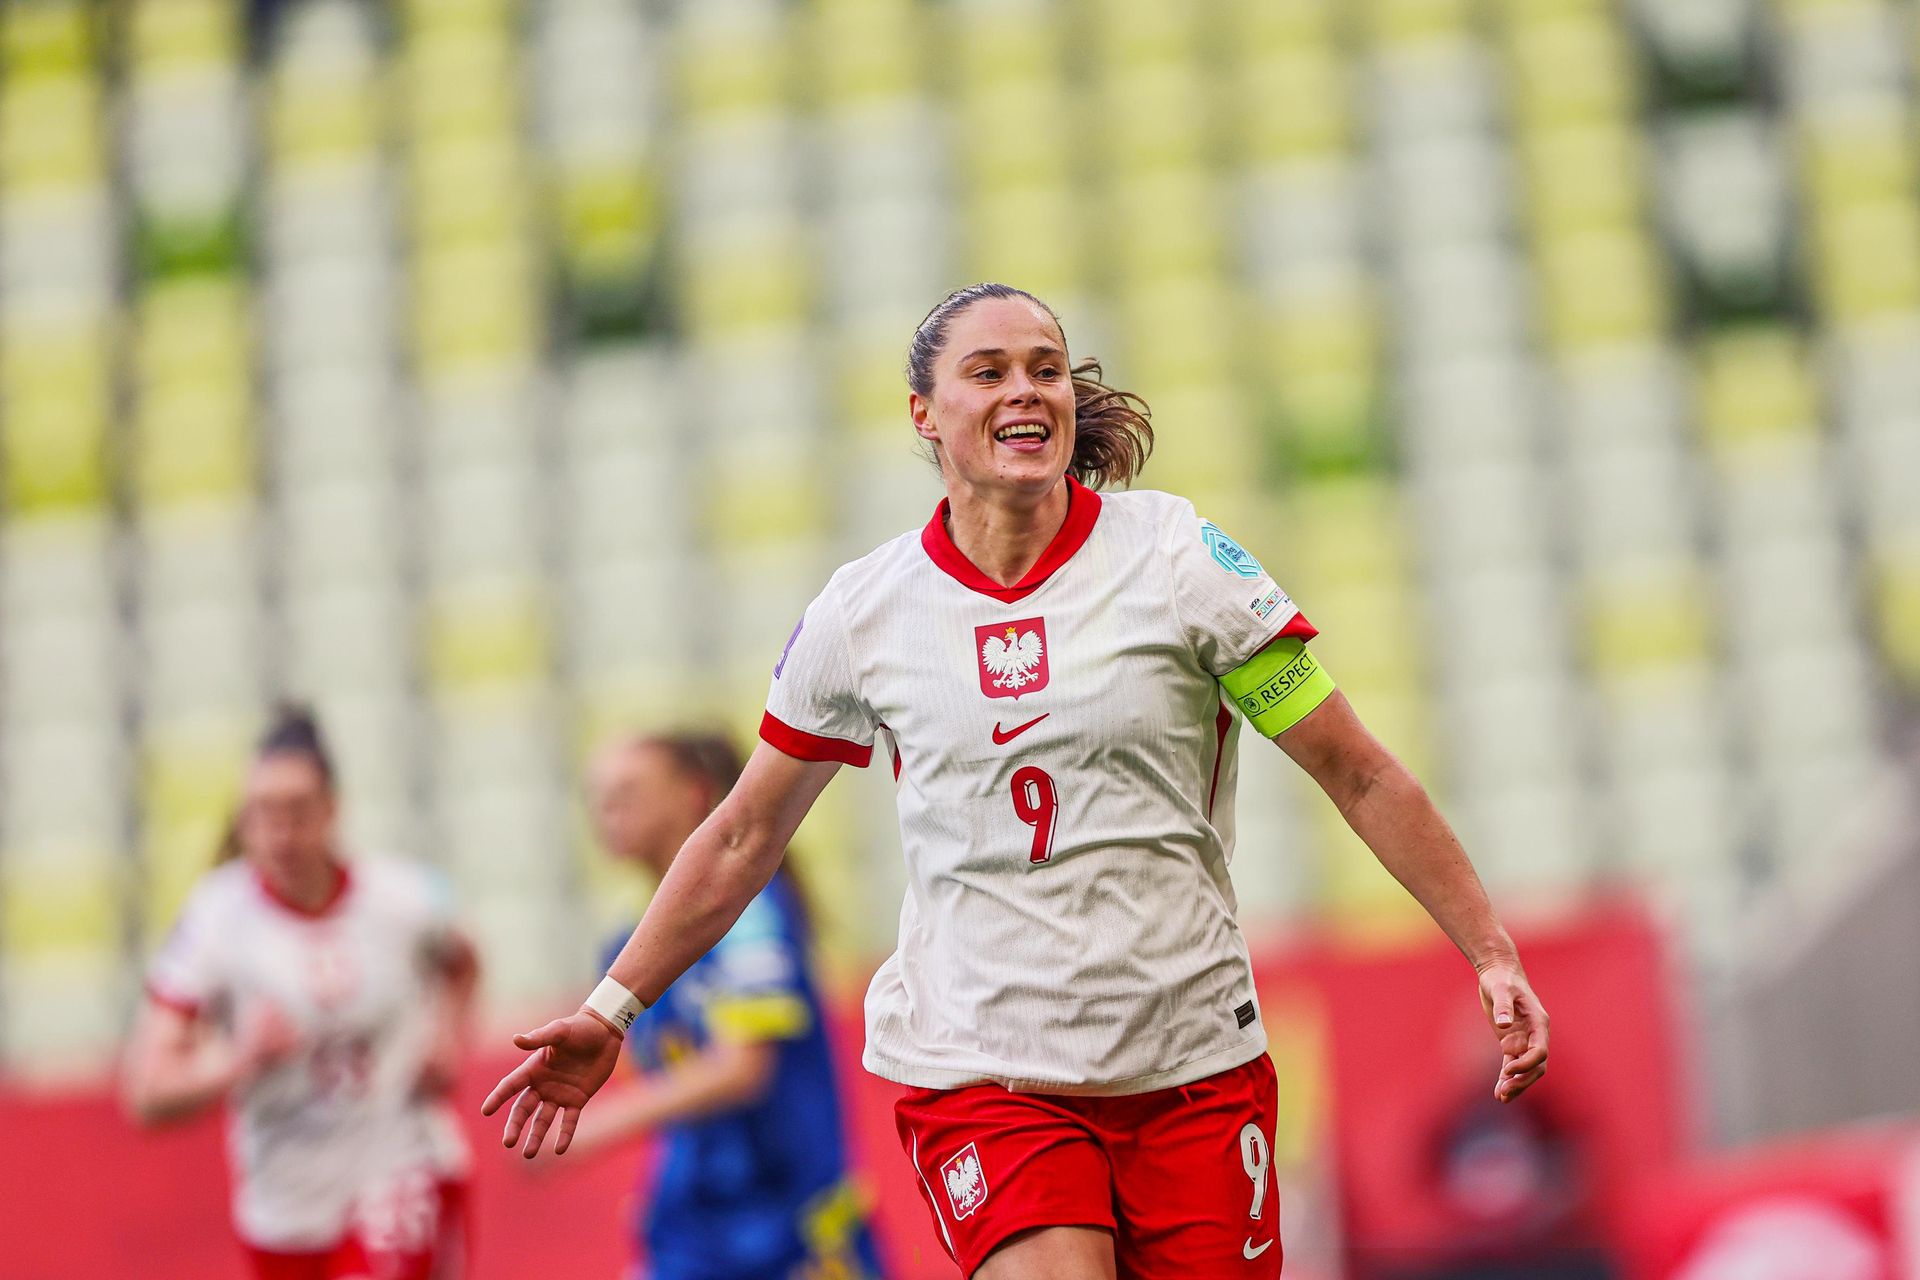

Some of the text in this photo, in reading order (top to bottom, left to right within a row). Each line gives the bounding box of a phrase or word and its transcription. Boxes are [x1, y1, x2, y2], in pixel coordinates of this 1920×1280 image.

[1260, 653, 1313, 704] RESPECT
[1010, 766, 1059, 864] 9
[1240, 1123, 1269, 1220] 9
